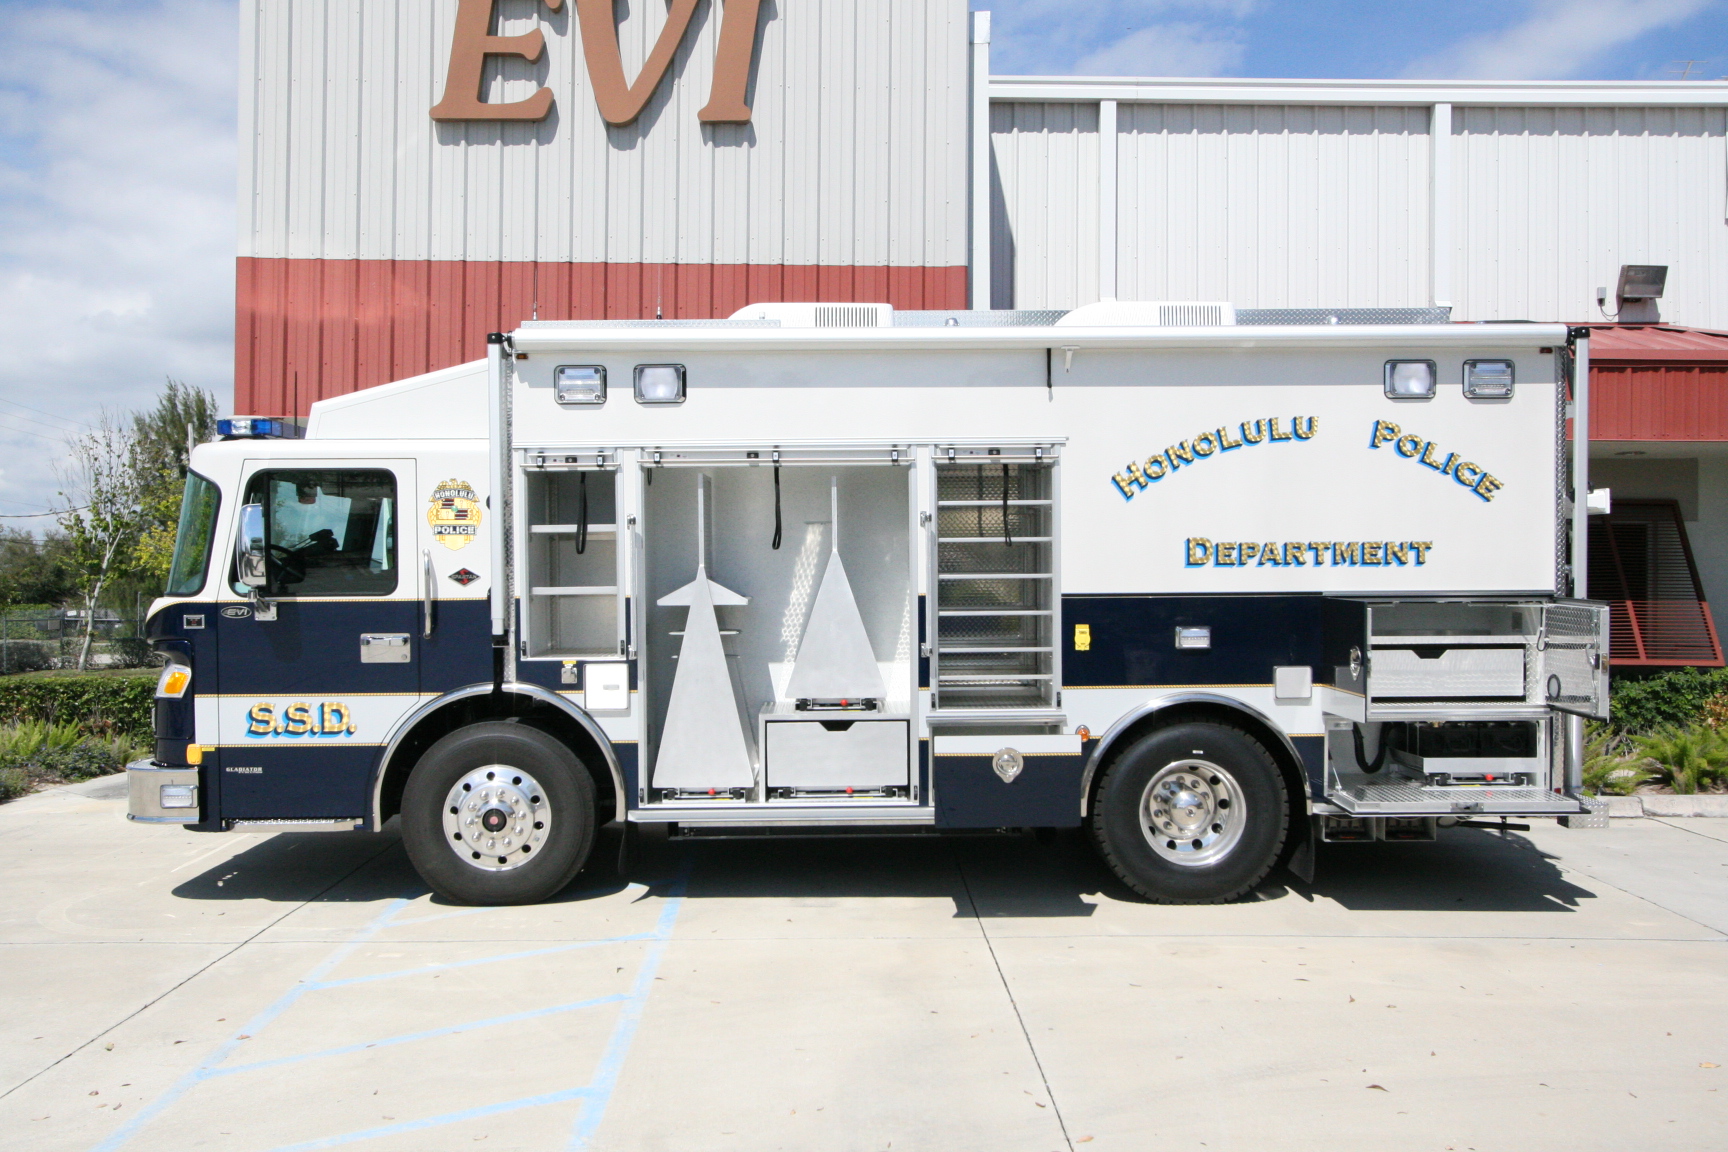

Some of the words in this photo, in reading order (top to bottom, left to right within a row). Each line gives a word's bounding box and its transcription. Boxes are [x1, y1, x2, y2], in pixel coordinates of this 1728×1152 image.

[429, 0, 760, 127] EVI
[1111, 415, 1319, 502] HONOLULU
[1369, 419, 1505, 502] POLICE
[434, 489, 475, 500] HONOLULU
[434, 525, 475, 534] POLICE
[1185, 537, 1432, 568] DEPARTMENT
[227, 608, 248, 616] EVI
[245, 702, 357, 739] S.S.D.
